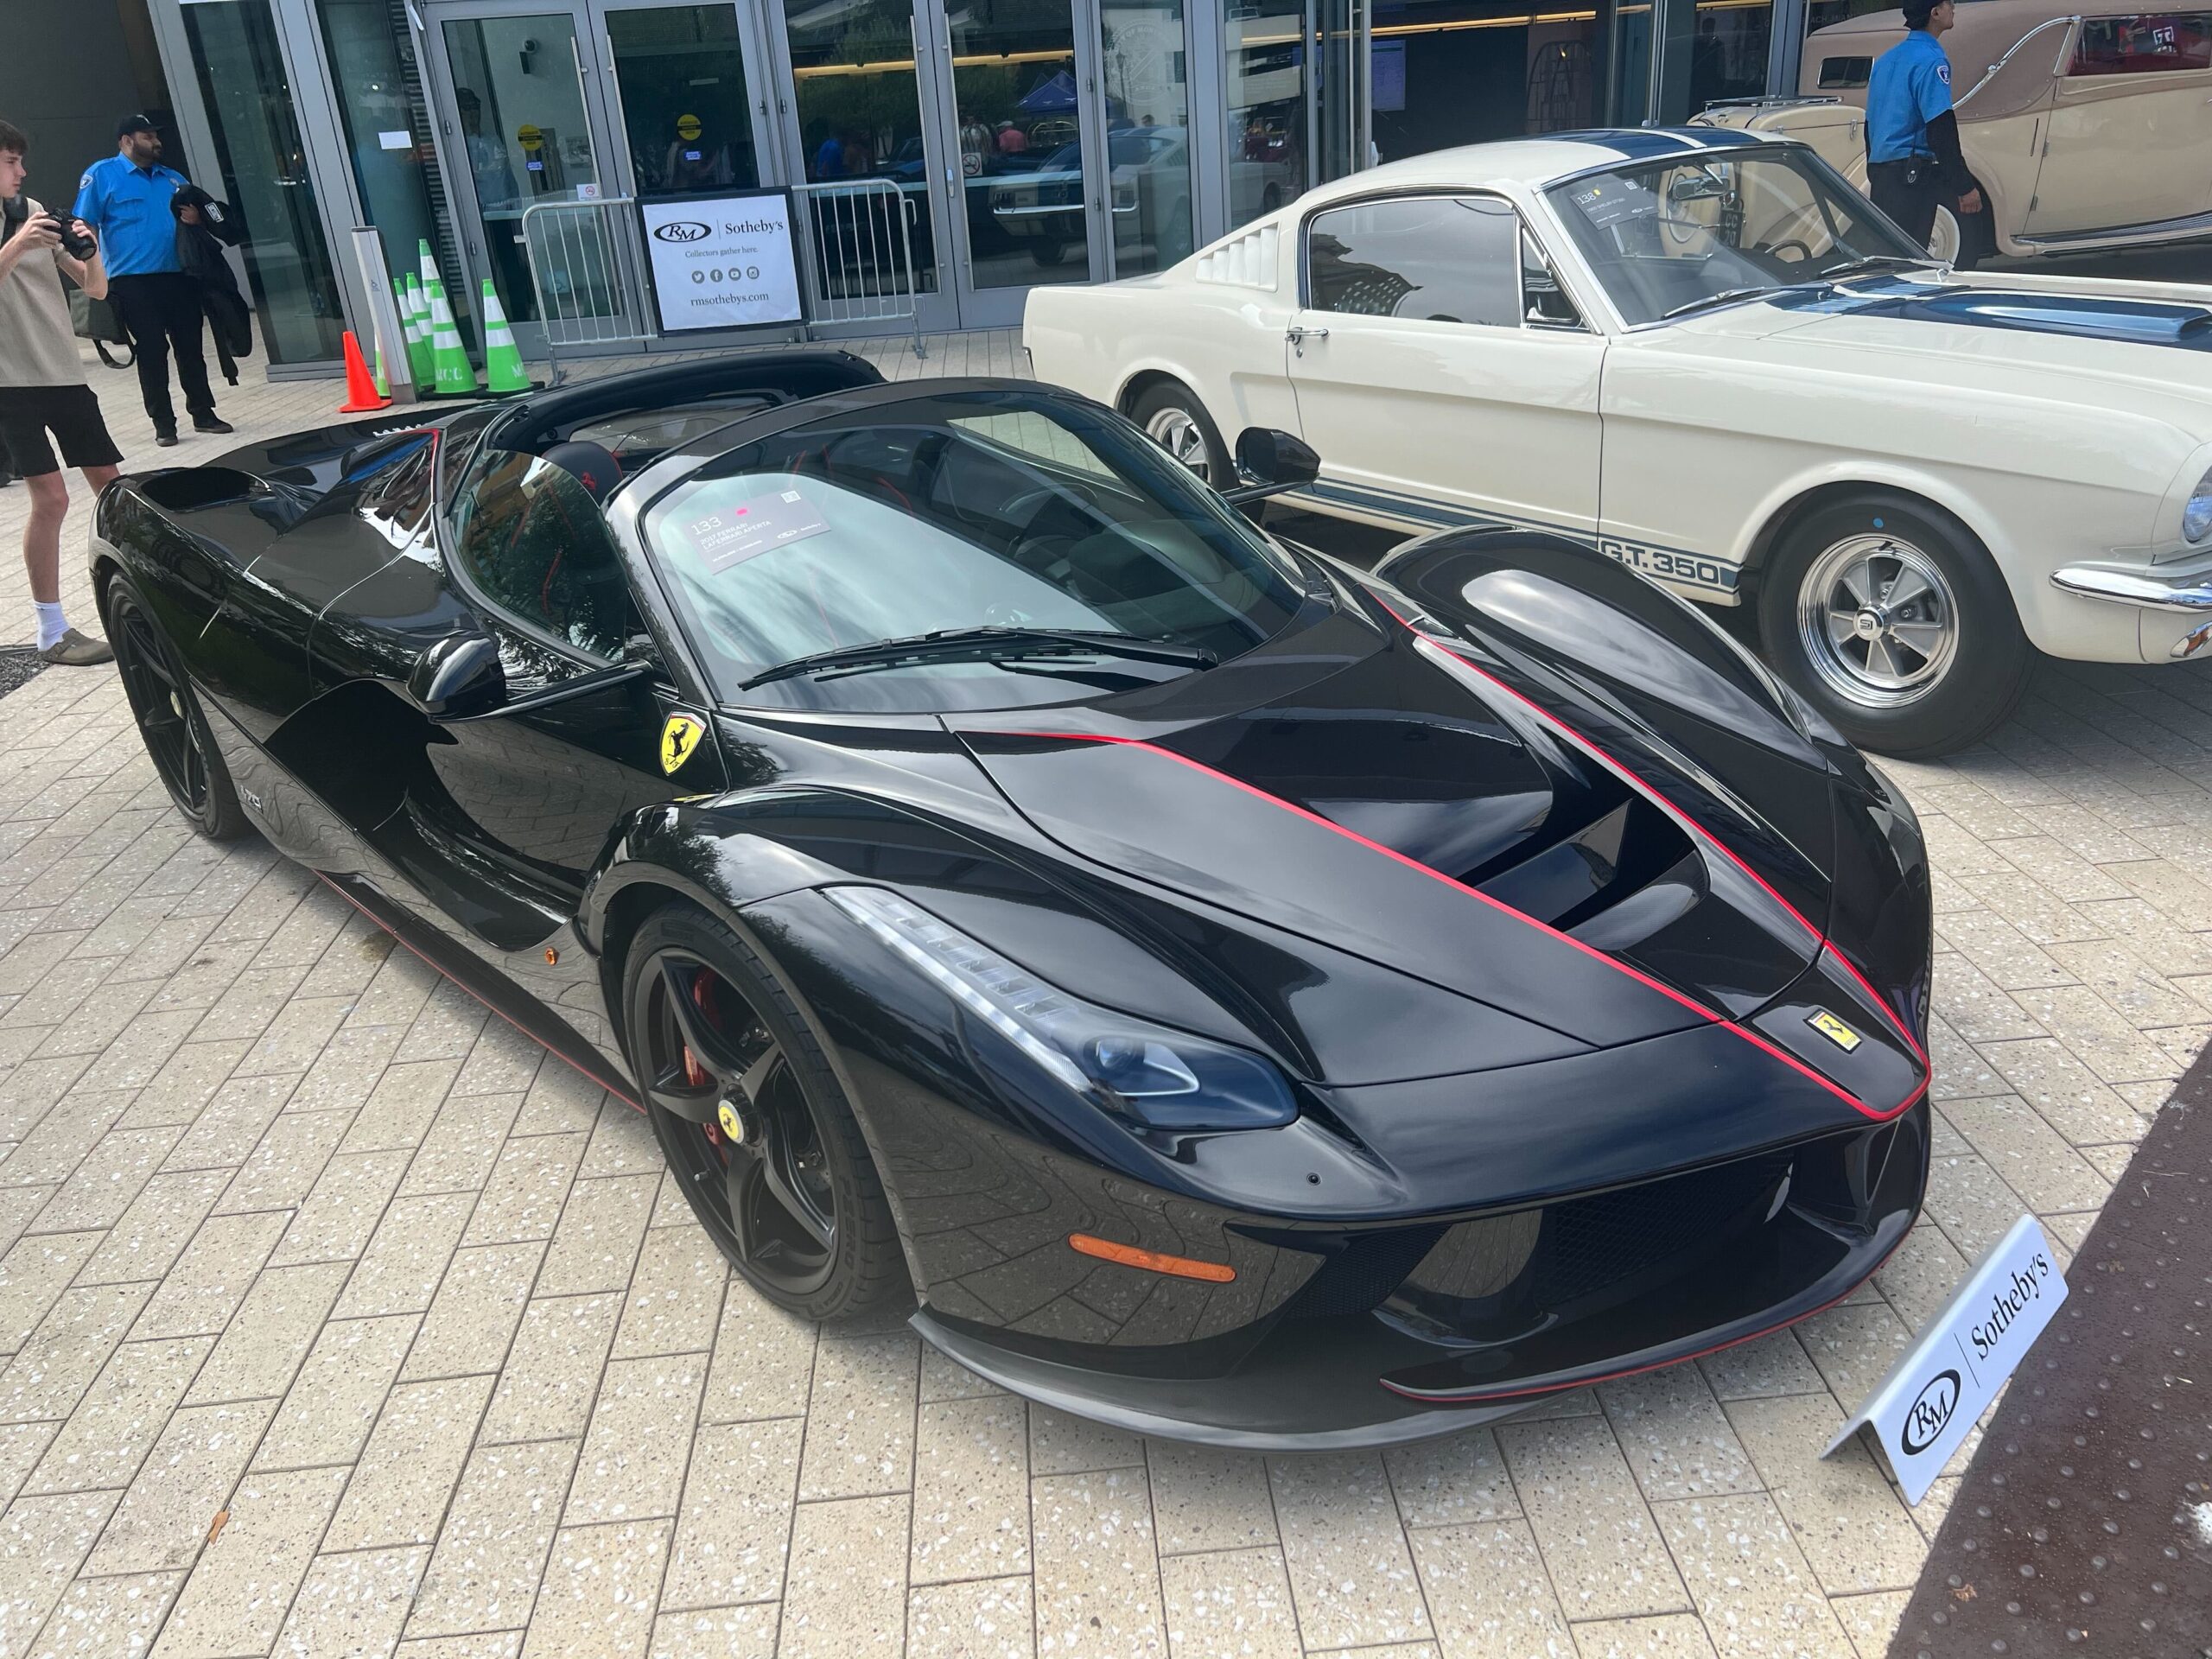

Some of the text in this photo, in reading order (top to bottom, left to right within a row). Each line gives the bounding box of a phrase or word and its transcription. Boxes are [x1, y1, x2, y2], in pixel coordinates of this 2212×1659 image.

[1577, 192, 1597, 205] 138
[725, 219, 784, 235] Sotheby's
[684, 249, 719, 258] Collectors
[720, 247, 741, 257] gather
[690, 292, 769, 307] rmsothebys.com
[435, 368, 462, 381] MCC
[691, 517, 722, 535] 133
[700, 533, 716, 545] 2017
[717, 523, 748, 539] FERRARI
[742, 520, 772, 536] APERTA
[1652, 552, 1719, 584] 350
[1971, 1252, 2049, 1362] Sotheby's
